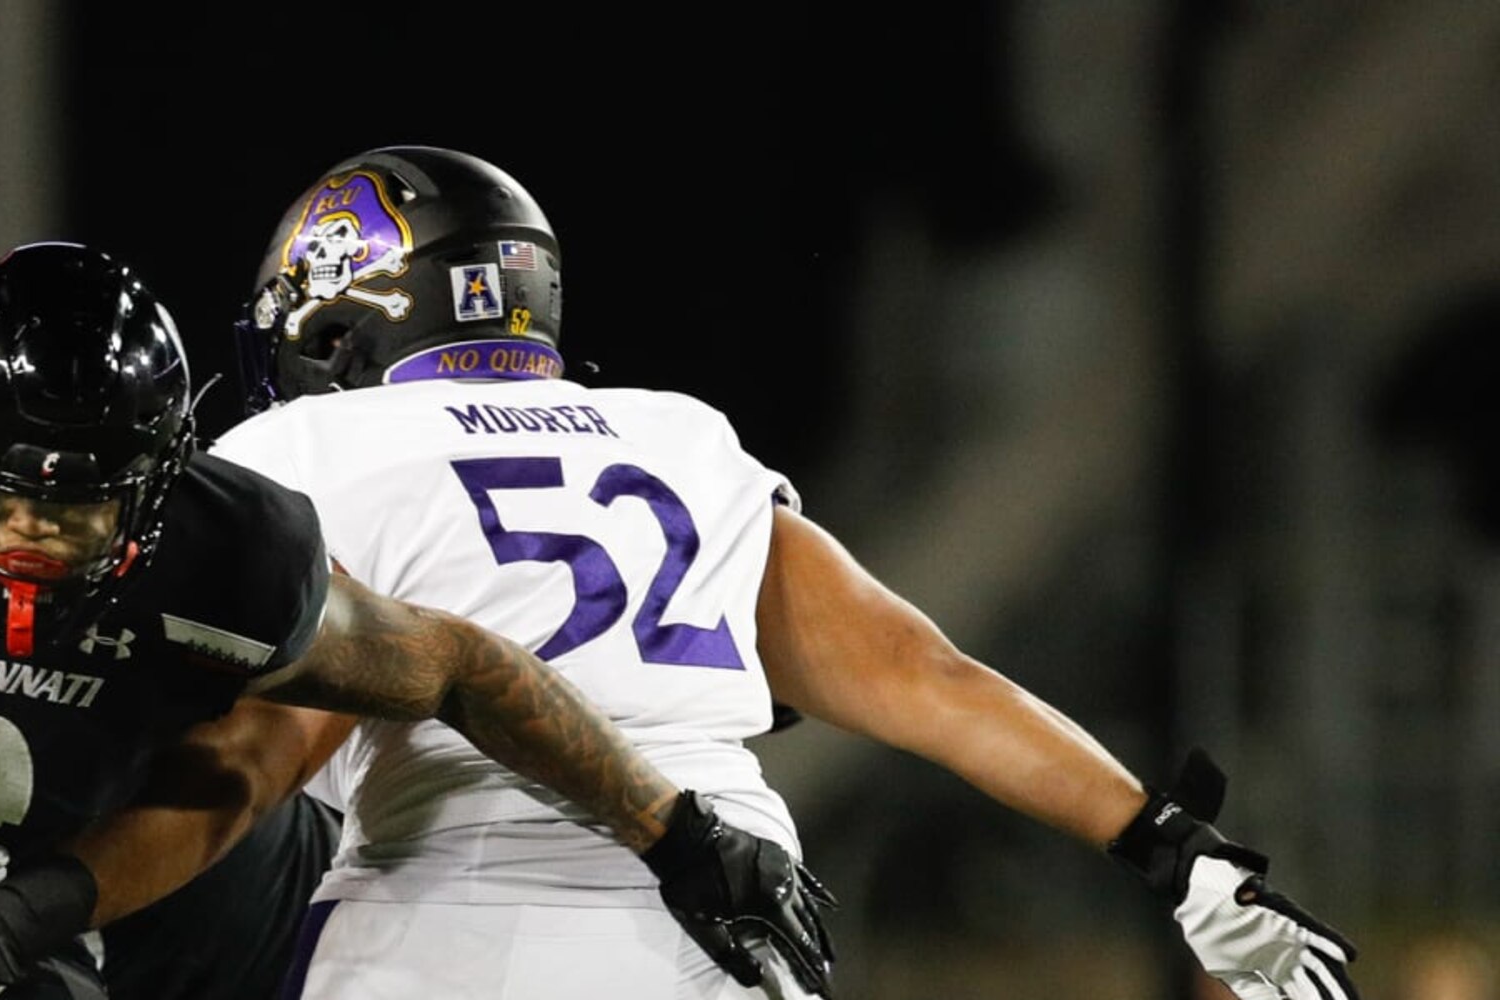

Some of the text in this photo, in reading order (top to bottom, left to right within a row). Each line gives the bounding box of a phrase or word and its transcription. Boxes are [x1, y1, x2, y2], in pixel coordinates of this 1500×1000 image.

[509, 308, 532, 336] 52
[436, 349, 564, 379] NO QUART
[444, 403, 621, 438] MOORER
[450, 456, 747, 671] 52
